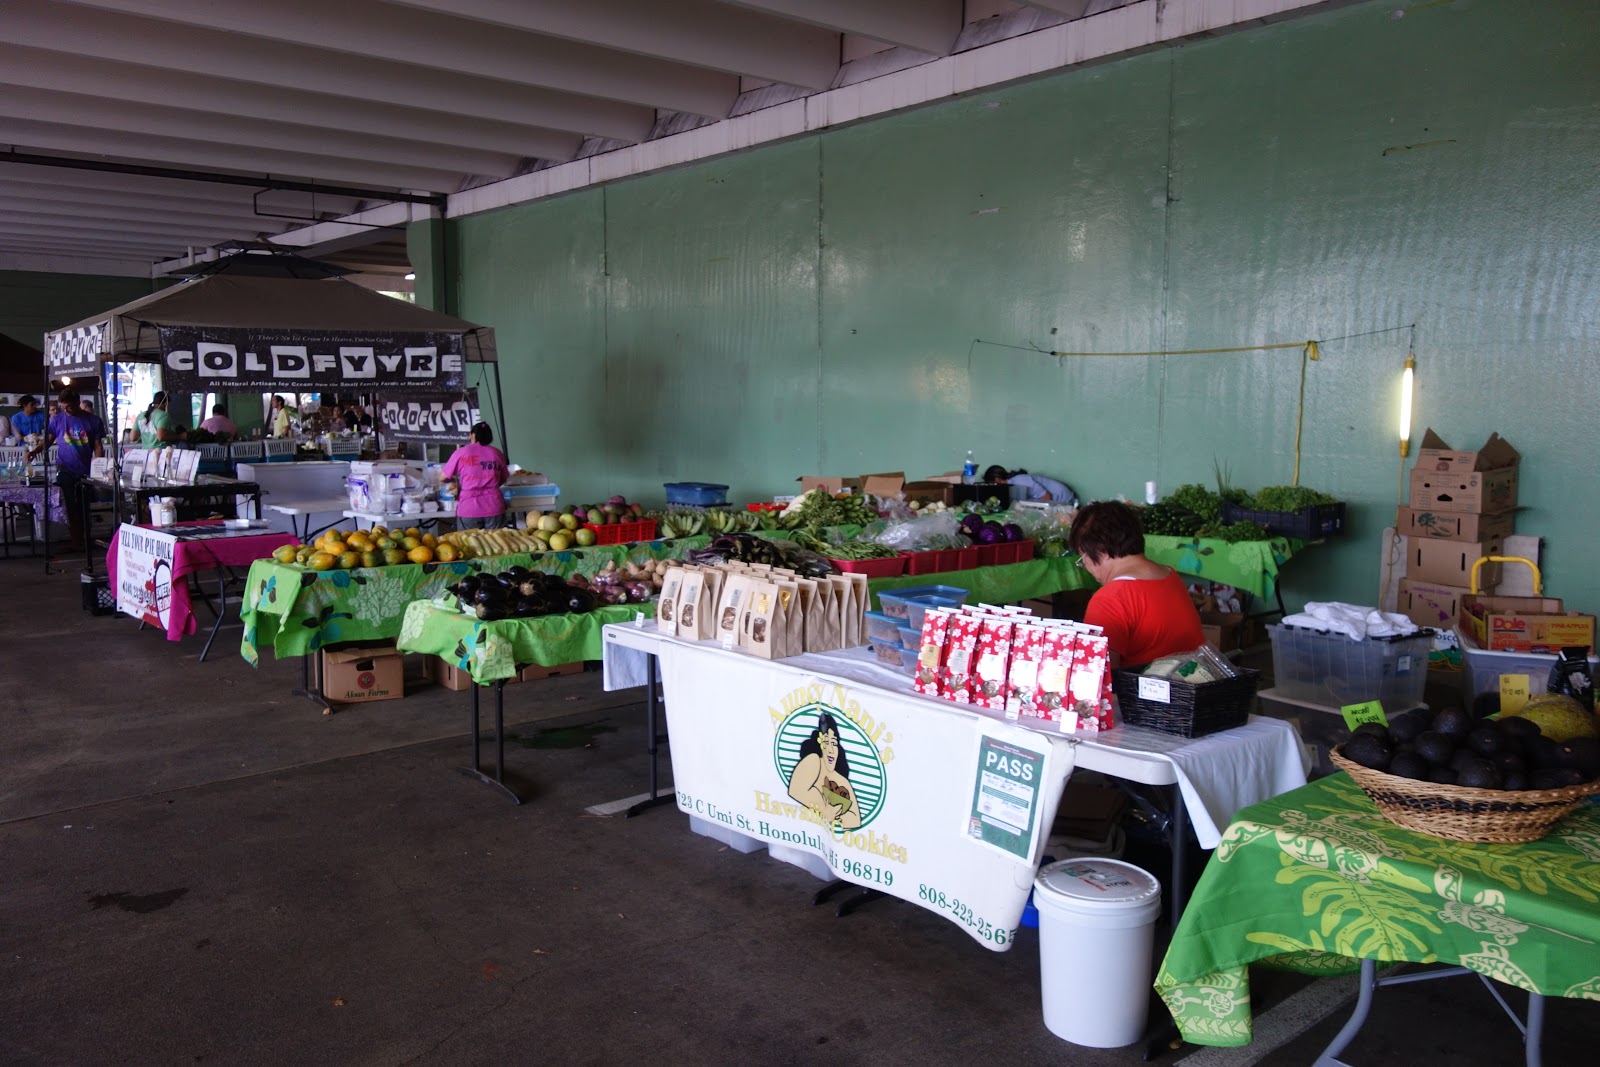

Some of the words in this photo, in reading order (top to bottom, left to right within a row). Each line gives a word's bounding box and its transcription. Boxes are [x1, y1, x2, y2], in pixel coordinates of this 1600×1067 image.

[51, 331, 102, 363] COLDFYRE
[166, 346, 462, 376] COLDFYRE
[381, 405, 481, 428] COLDFYRE
[1493, 617, 1525, 629] Dole
[344, 690, 365, 698] Aloun
[368, 688, 389, 696] Farms
[826, 684, 895, 765] Nani's
[986, 751, 1034, 781] PASS
[695, 799, 704, 813] C
[707, 803, 733, 825] Umi
[736, 814, 755, 832] St.
[843, 858, 894, 887] 96819
[831, 819, 908, 864] Cookies
[919, 884, 1017, 945] 808-223-2565
